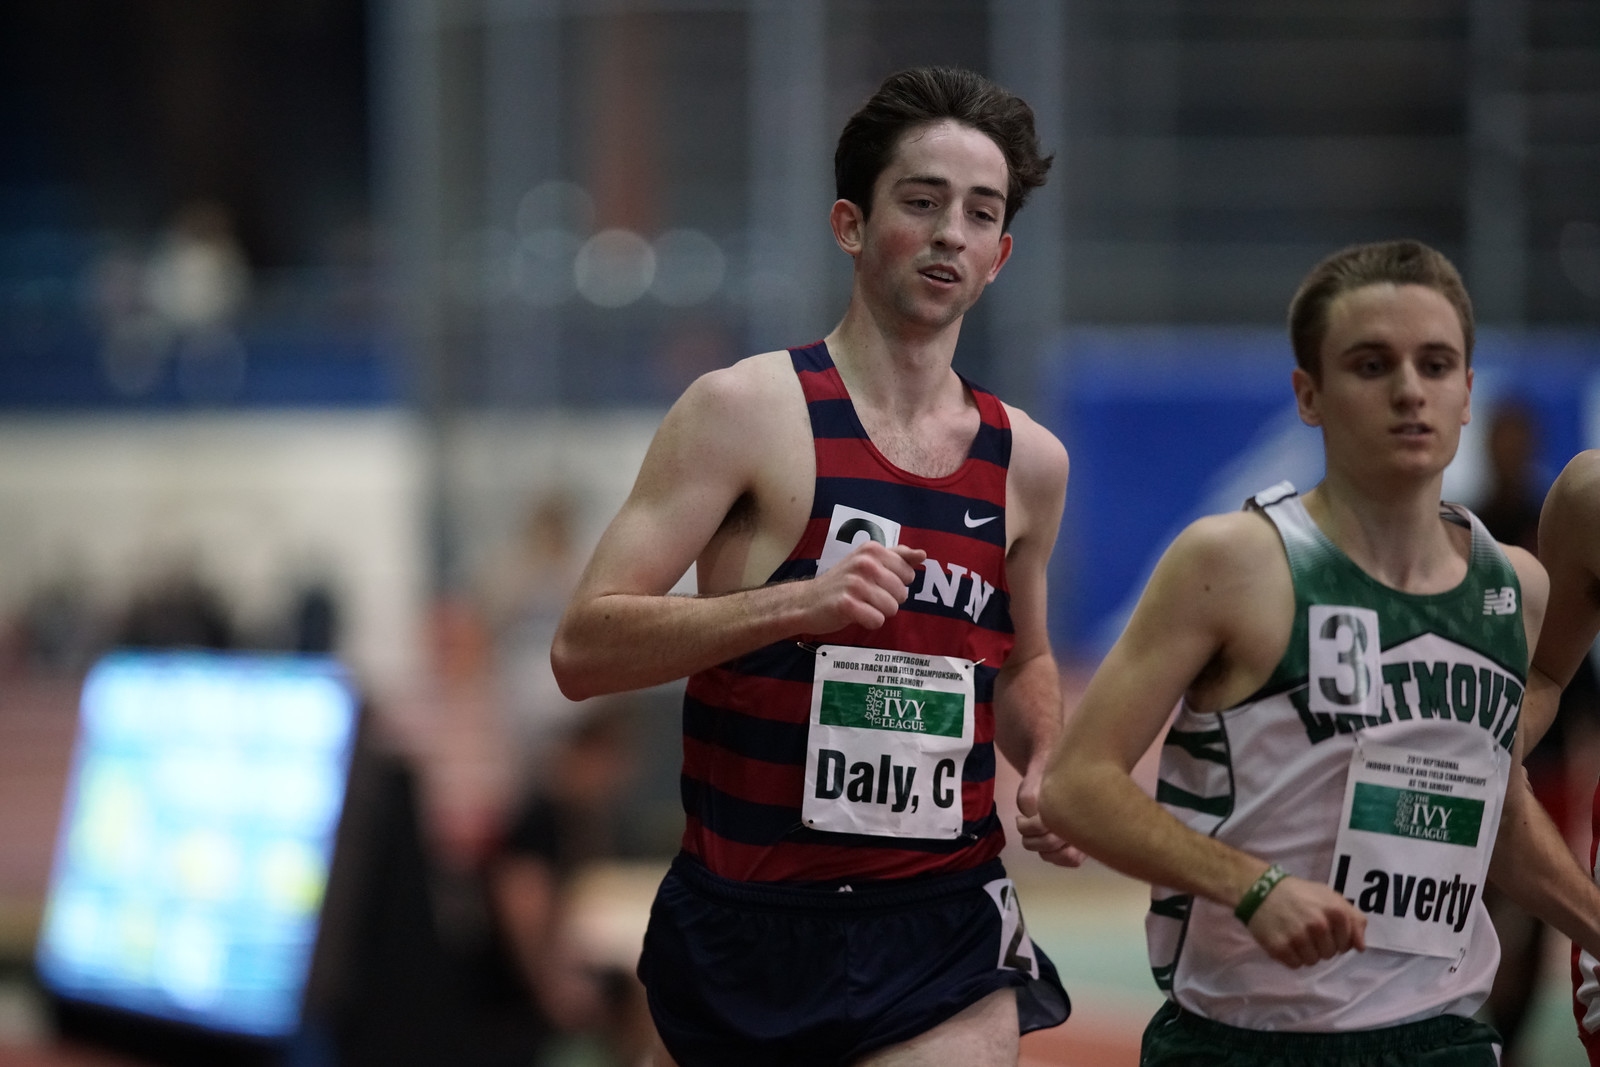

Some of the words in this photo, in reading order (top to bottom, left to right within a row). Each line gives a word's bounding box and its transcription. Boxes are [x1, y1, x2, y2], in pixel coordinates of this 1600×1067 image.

[875, 653, 891, 664] 2017
[891, 655, 931, 667] HEPTAGONAL
[1318, 613, 1371, 706] 3
[833, 660, 859, 671] INDOOR
[860, 663, 883, 673] TRACK
[884, 665, 898, 674] AND
[898, 667, 914, 676] FIELD
[914, 669, 964, 681] CHAMPIONSHIPS
[876, 675, 887, 684] AT
[887, 675, 899, 685] THE
[899, 677, 925, 688] ARMORY
[884, 688, 903, 698] THE
[882, 696, 926, 721] IVY
[882, 718, 926, 732] LEAGUE
[815, 748, 920, 814] Daly,
[933, 758, 956, 809] C
[1365, 760, 1392, 773] INDOOR
[1392, 764, 1415, 776] TRACK
[1415, 767, 1428, 778] AND
[1428, 769, 1444, 780] FIELD
[1444, 772, 1487, 788] CHAMPIONSHIPS
[1408, 778, 1417, 788] AT
[1417, 779, 1428, 789] THE
[1428, 781, 1454, 793] ARMORY
[1414, 793, 1430, 805] THE
[1411, 803, 1453, 829] IVY
[1409, 824, 1452, 841] LEAGUE
[1334, 854, 1477, 933] Laverty
